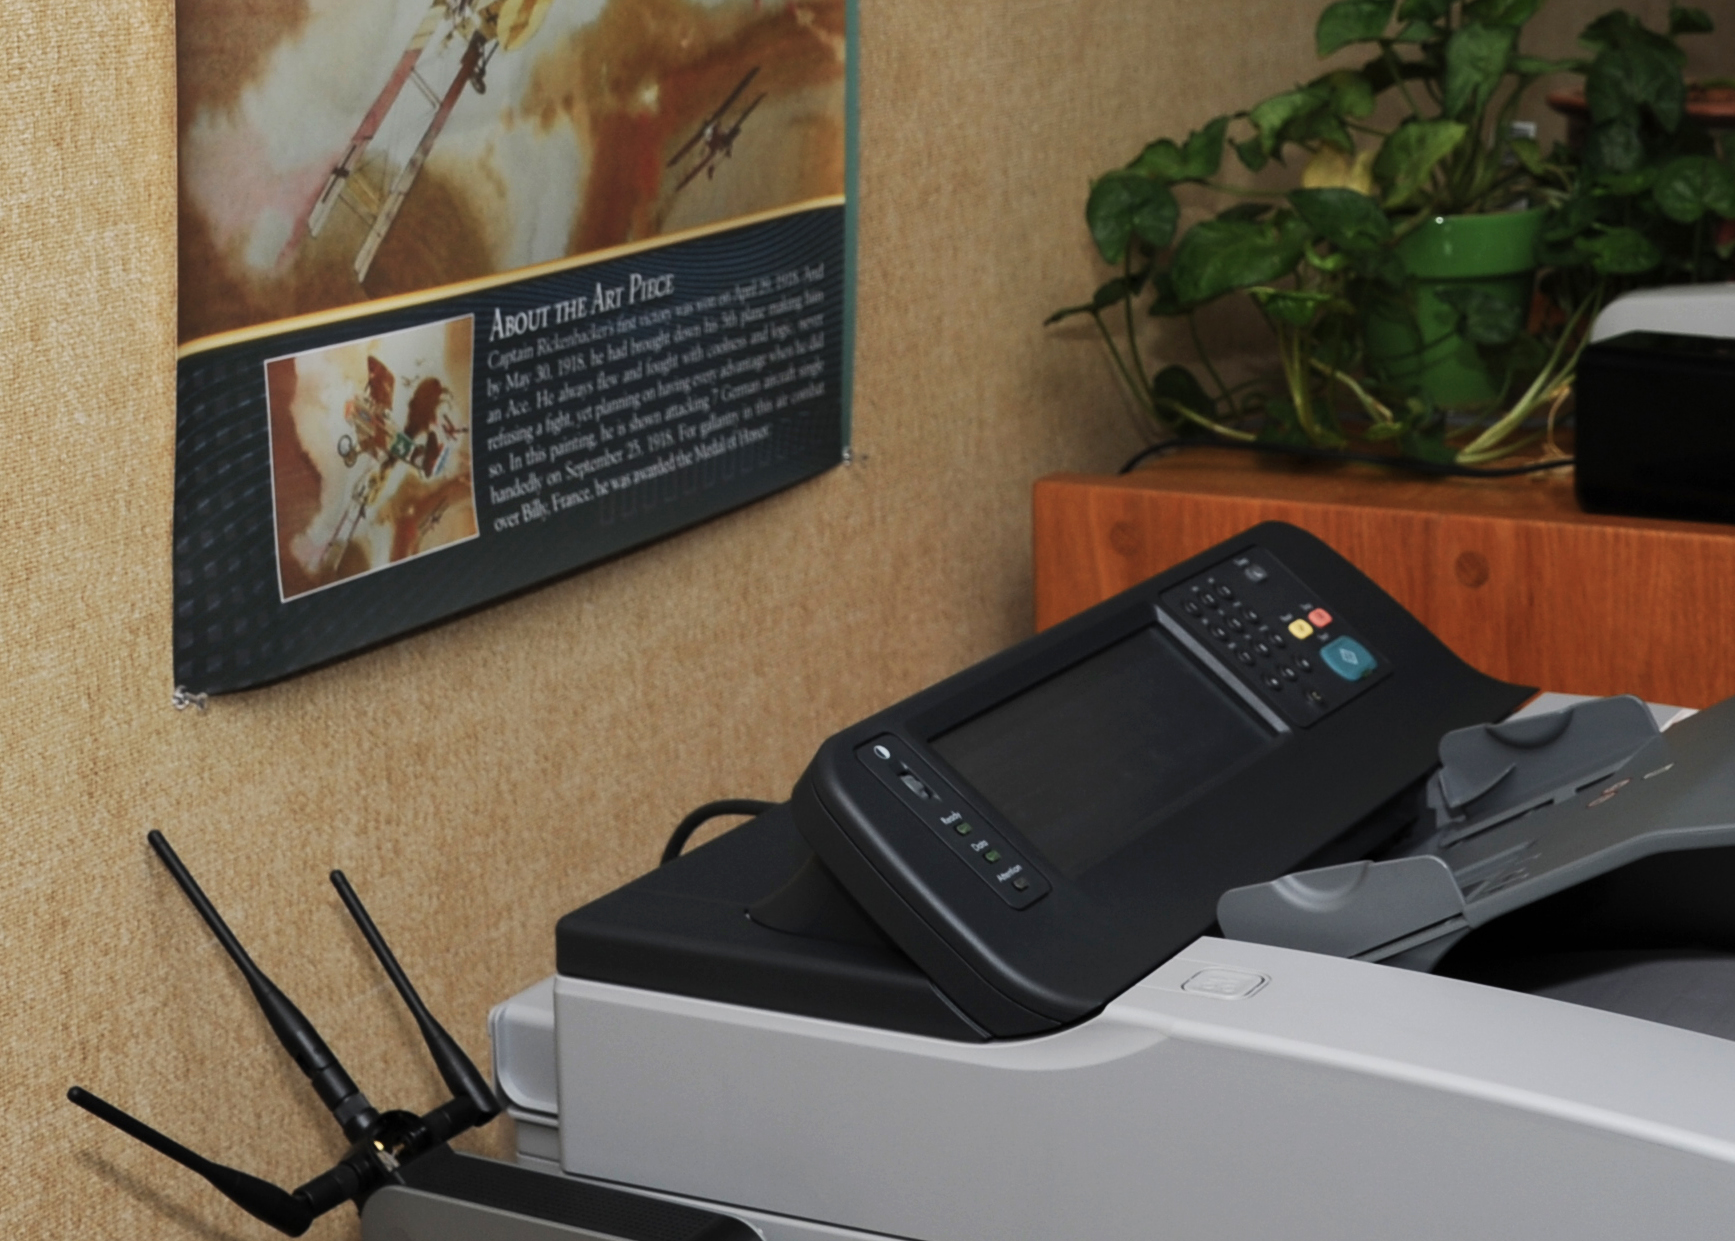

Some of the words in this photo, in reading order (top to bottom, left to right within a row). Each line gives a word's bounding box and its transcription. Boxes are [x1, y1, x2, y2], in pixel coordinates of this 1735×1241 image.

[489, 307, 551, 342] ABOUT
[554, 296, 588, 324] THE
[591, 282, 625, 315] ART
[629, 273, 675, 305] PIECE
